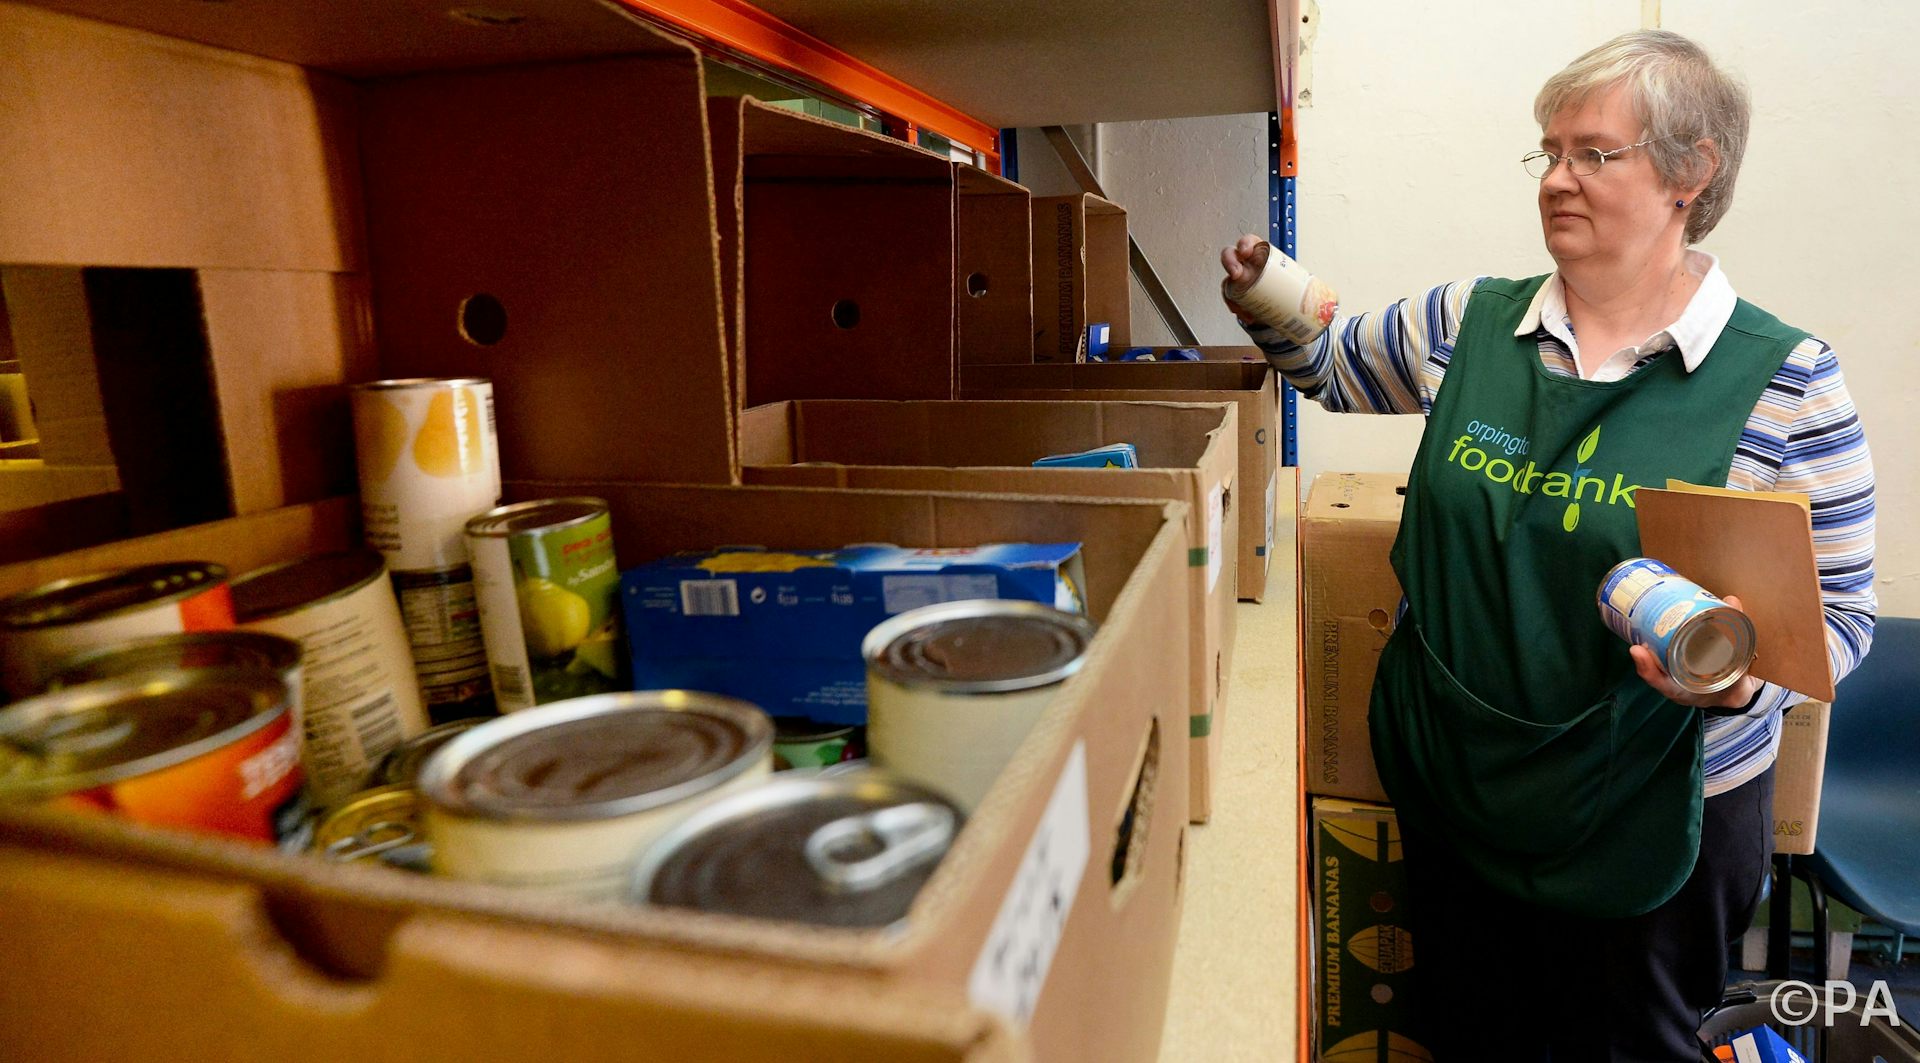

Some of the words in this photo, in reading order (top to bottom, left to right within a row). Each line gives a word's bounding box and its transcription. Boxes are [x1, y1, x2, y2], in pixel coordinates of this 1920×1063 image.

[1057, 203, 1072, 278] BANANAS
[1058, 281, 1073, 353] PREMIUM
[1324, 620, 1339, 700] PREMIUM
[1324, 706, 1339, 784] BANANAS
[1325, 855, 1340, 944] BANANAS
[1327, 947, 1341, 1027] PREMIUM
